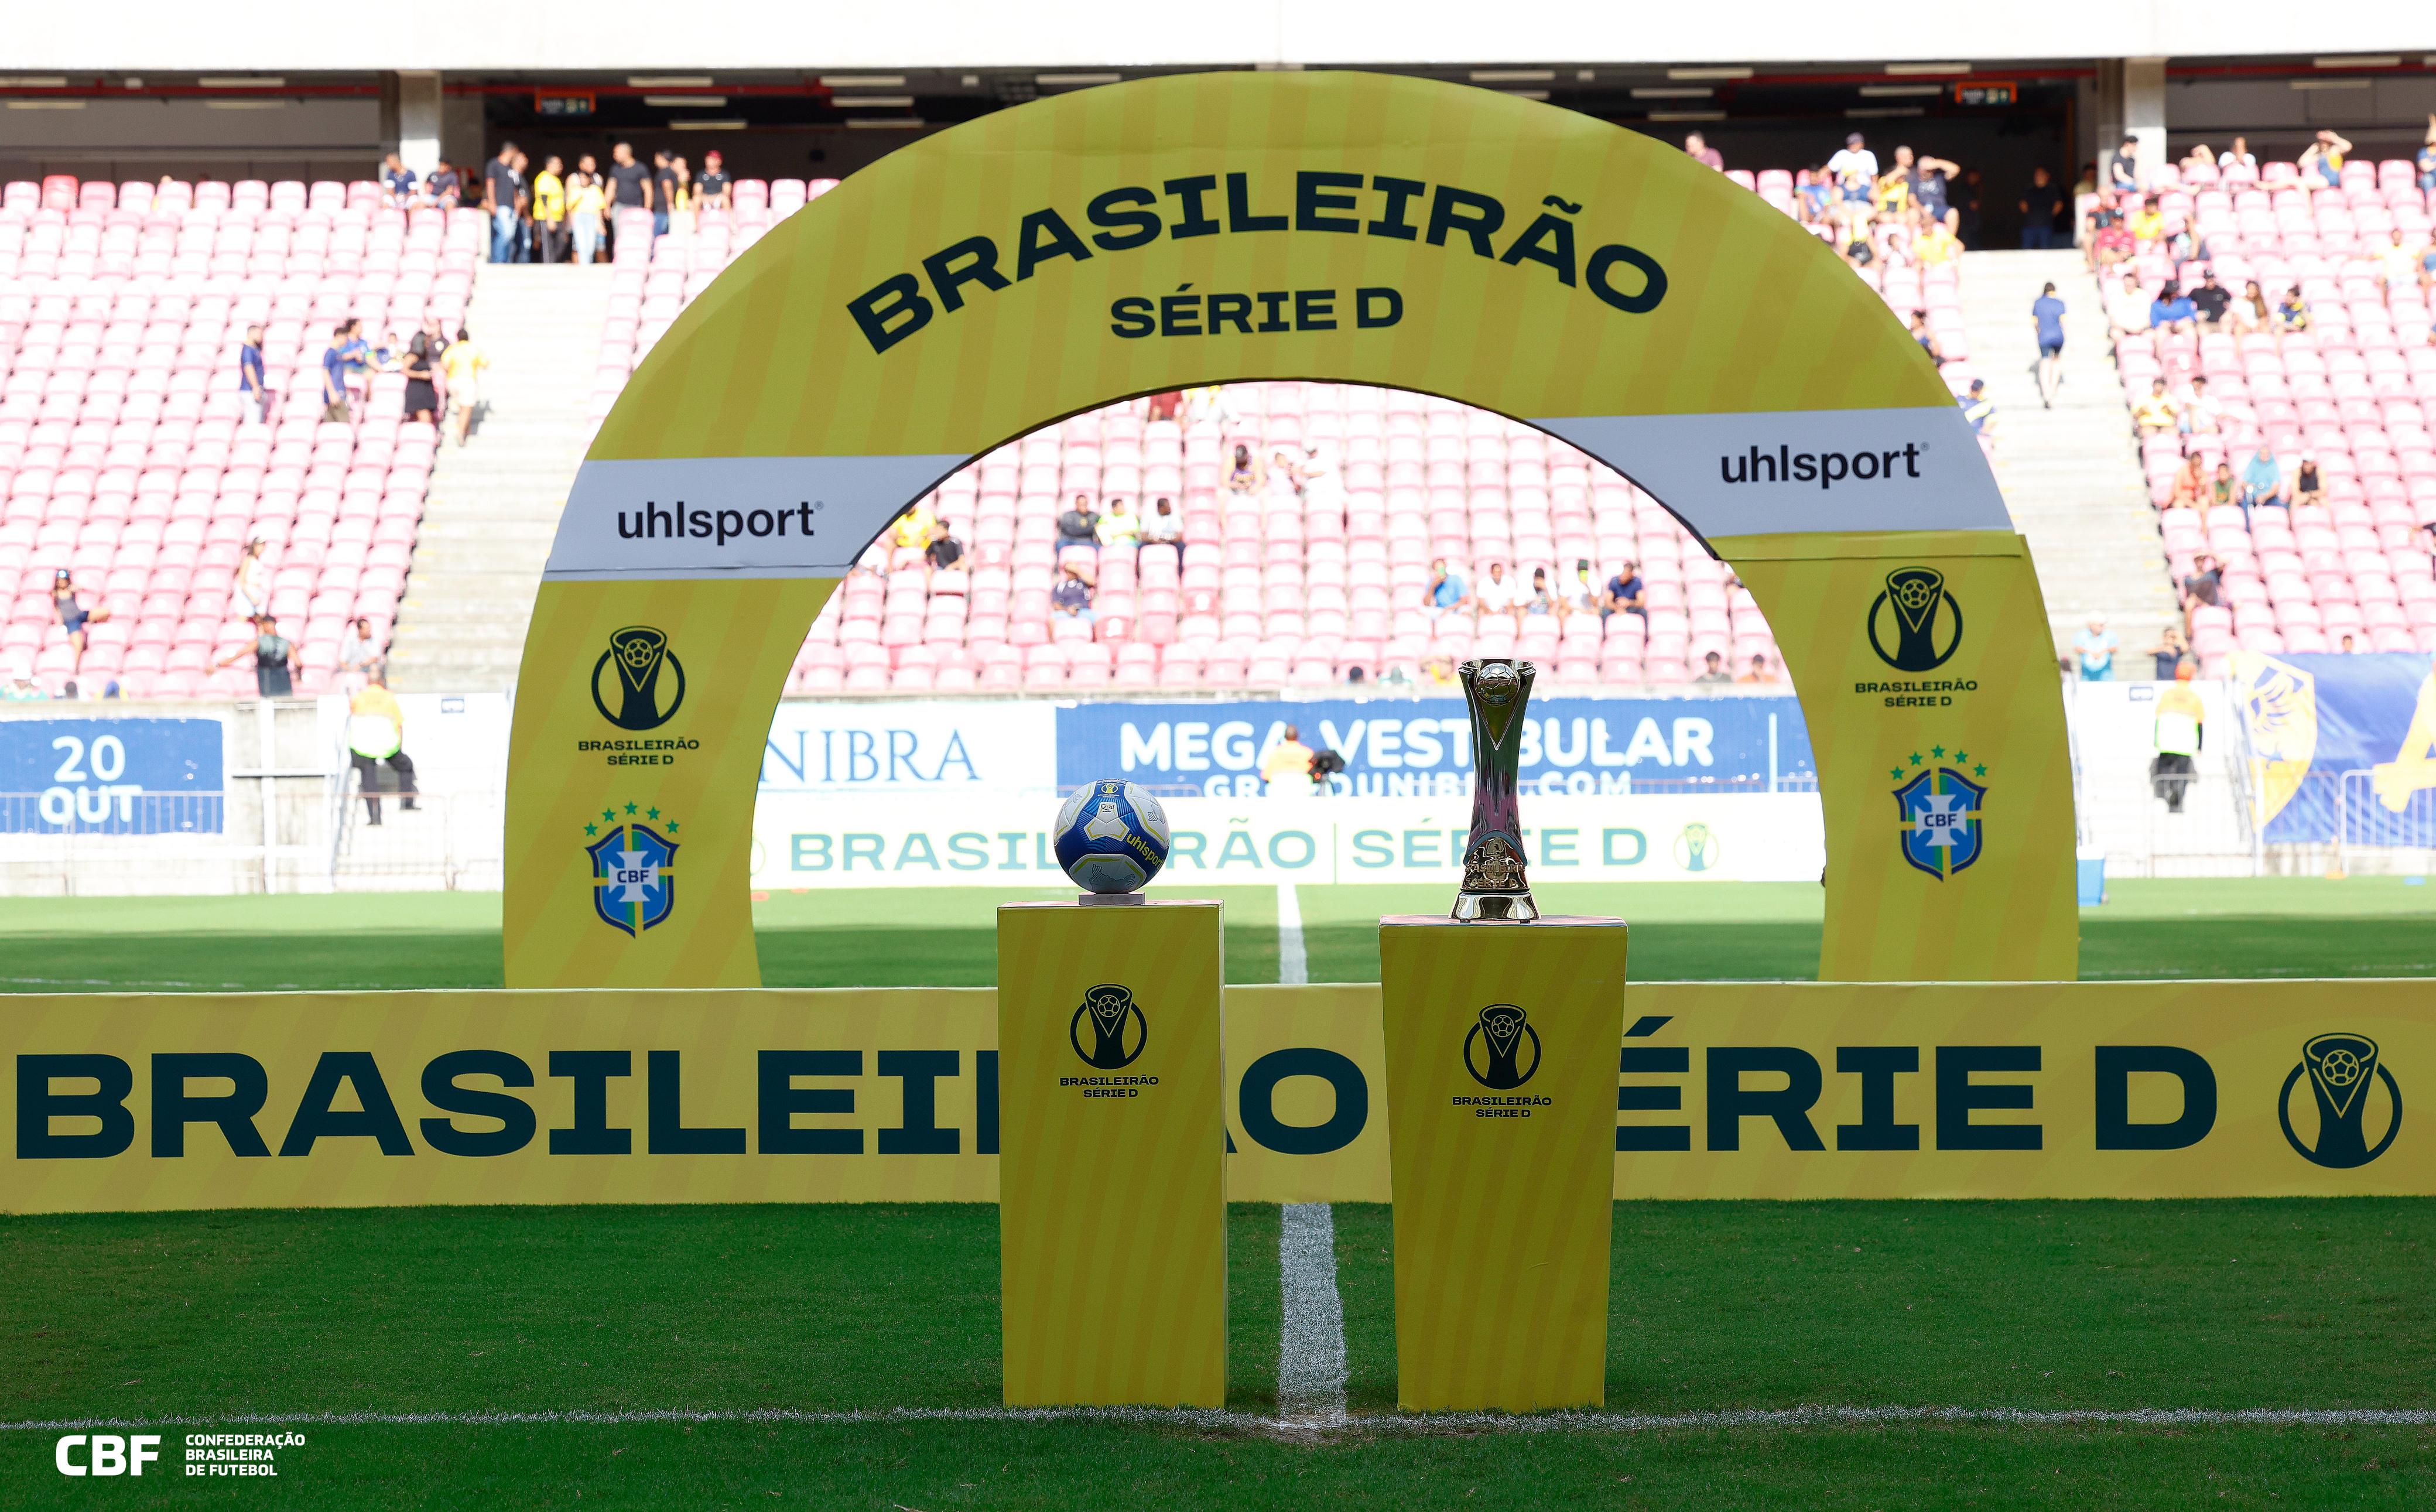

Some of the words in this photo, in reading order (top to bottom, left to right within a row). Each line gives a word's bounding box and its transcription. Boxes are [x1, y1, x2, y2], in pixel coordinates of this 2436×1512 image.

[847, 171, 1668, 355] BRASILEIRÃO
[1111, 283, 1337, 338] SÉRIE
[1356, 287, 1403, 329] D
[1721, 443, 1920, 490] uhlsport
[618, 501, 815, 546] uhlsport
[1855, 678, 1978, 693] BRASILEIRÃO
[1884, 695, 1937, 707] SÉRIE
[1940, 696, 1953, 706] D
[578, 737, 699, 751] BRASILEIRÃO
[1318, 717, 1714, 768] VESTBULAR
[52, 734, 126, 782] 20
[607, 752, 659, 765] SÉRIE
[662, 755, 674, 765] D
[759, 730, 982, 783] NIBRA
[39, 784, 143, 825] OUT
[1924, 814, 1957, 827] CBF
[1603, 829, 1647, 866] D
[617, 870, 649, 883] CBF
[1060, 1074, 1159, 1086] BRASILEIRÃO
[1083, 1087, 1126, 1098] SÉRIE
[1128, 1089, 1138, 1097] D
[1615, 1016, 2043, 1151] ÉRIE
[2095, 1045, 2217, 1150] D
[1452, 1094, 1552, 1106] BRASILEIRÃO
[1476, 1107, 1518, 1118] SÉRIE
[1521, 1109, 1531, 1118] D
